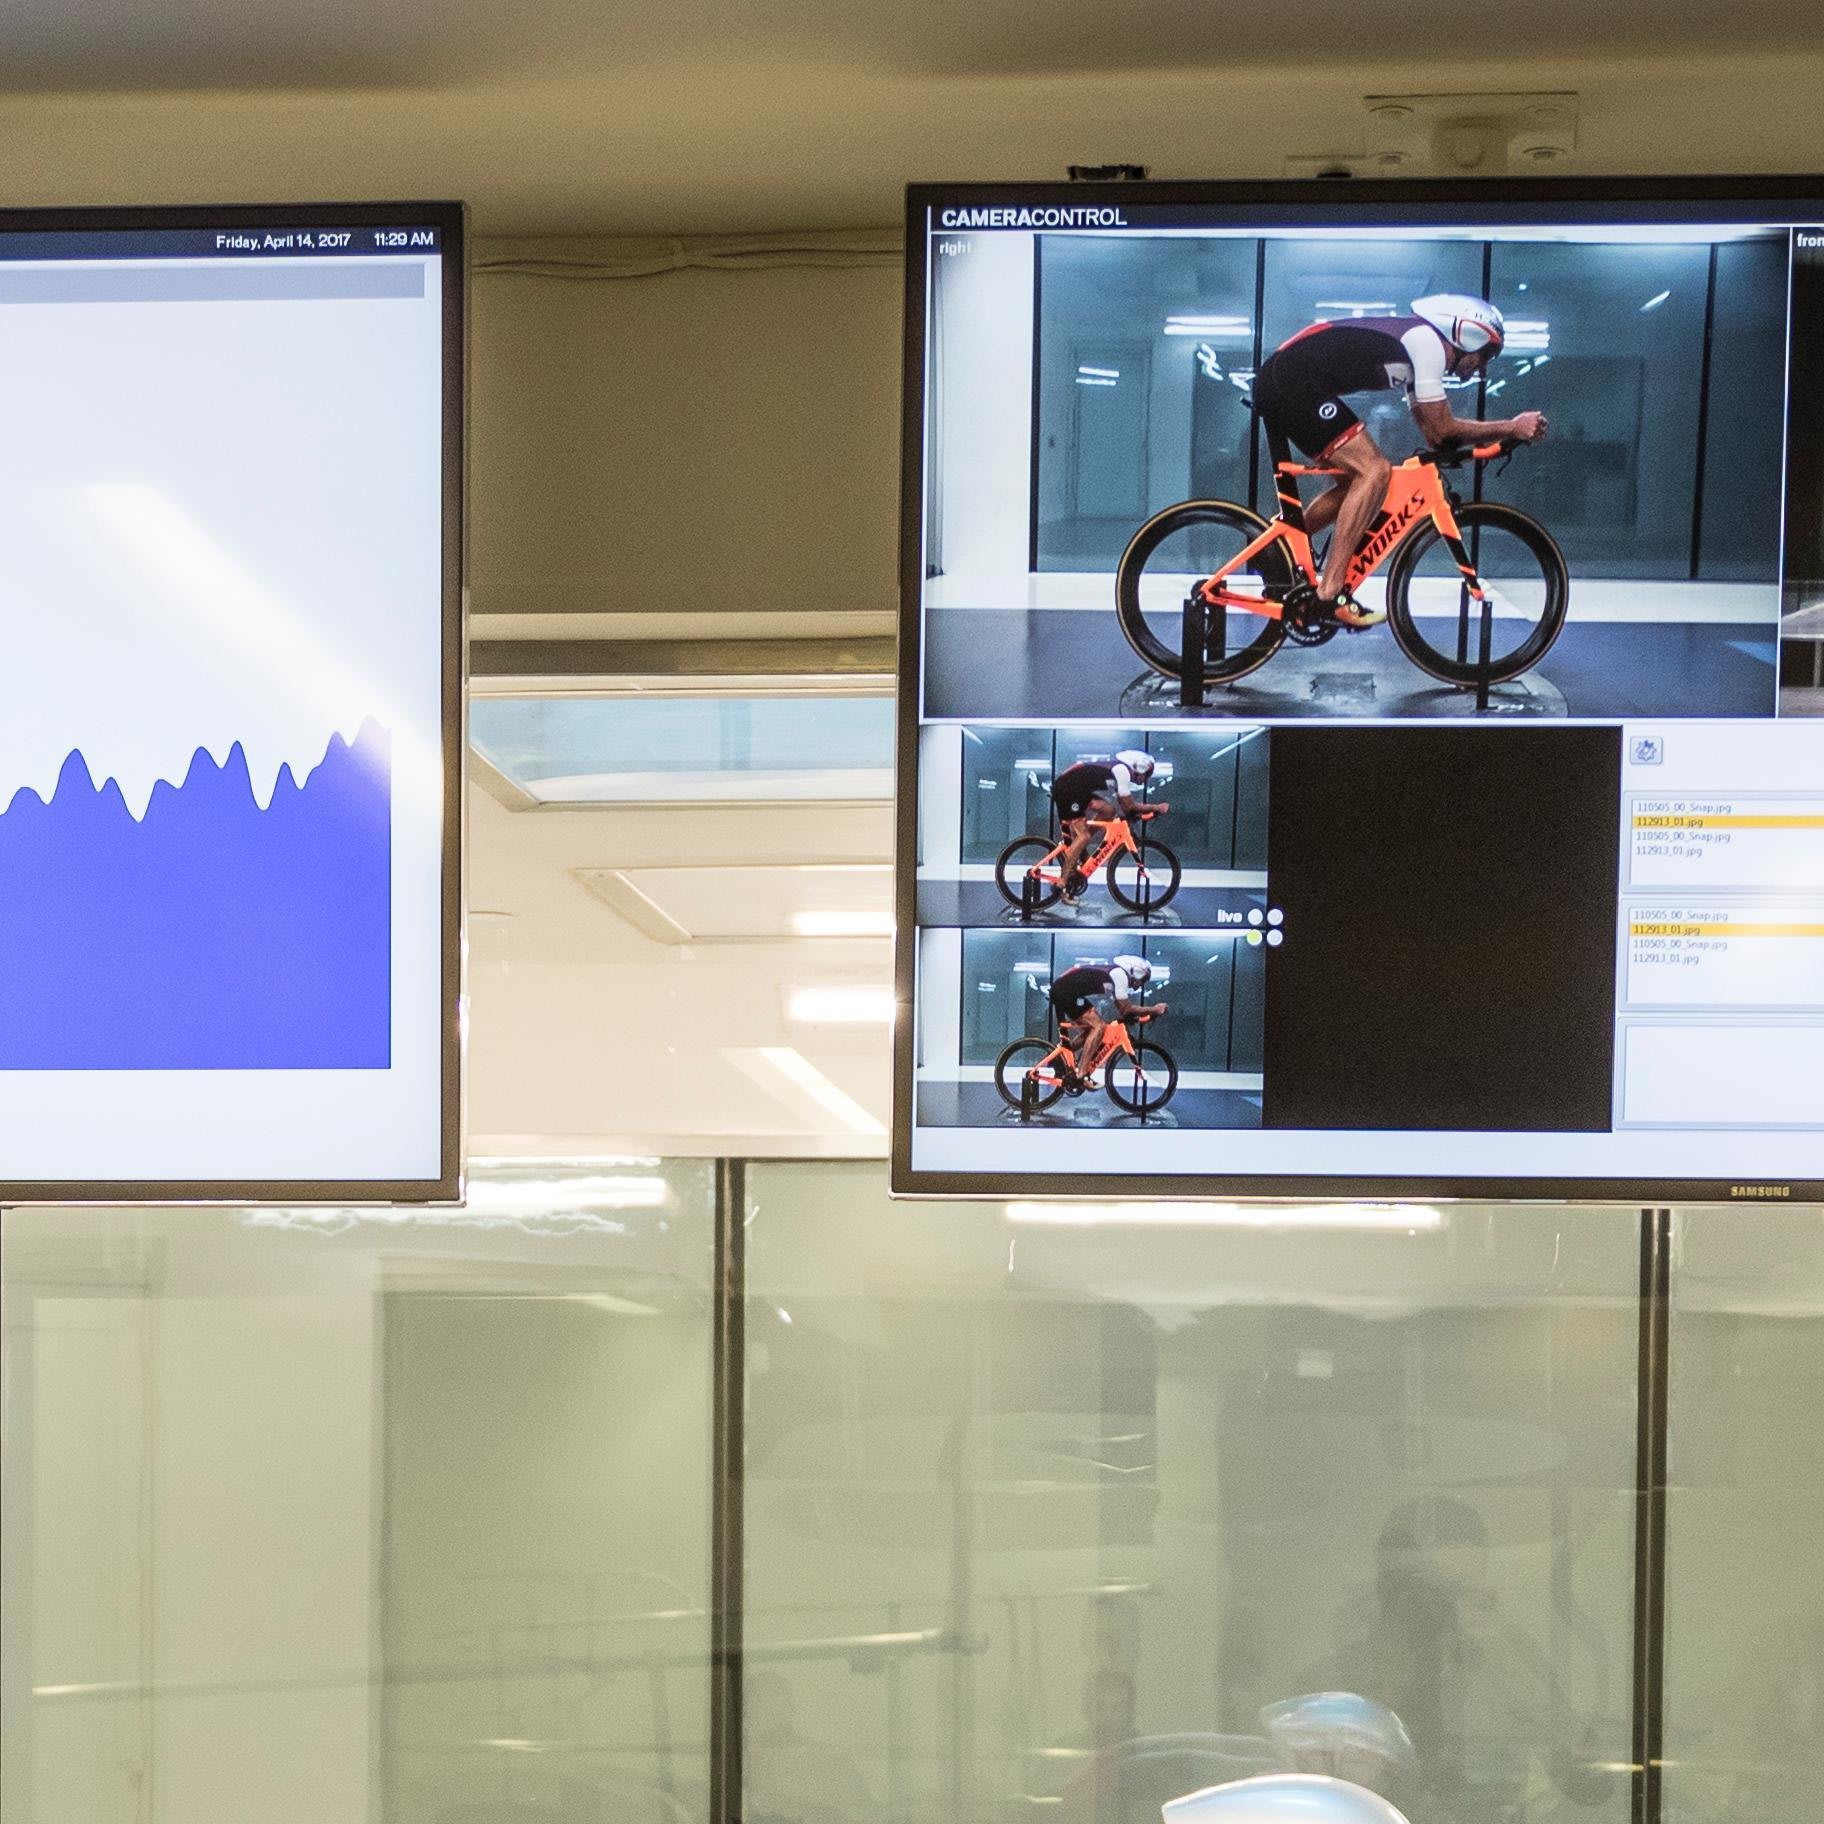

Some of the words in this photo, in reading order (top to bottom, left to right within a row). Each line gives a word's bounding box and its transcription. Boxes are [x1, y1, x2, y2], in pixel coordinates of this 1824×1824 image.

[941, 208, 1128, 227] CAMERACONTROL
[216, 235, 261, 250] Friday,
[263, 234, 293, 250] April
[297, 234, 315, 248] 14,
[318, 233, 351, 247] 2017
[374, 232, 408, 246] 11:29
[410, 231, 434, 245] AM
[939, 240, 972, 257] right
[1730, 1185, 1791, 1197] SAMSUNG
